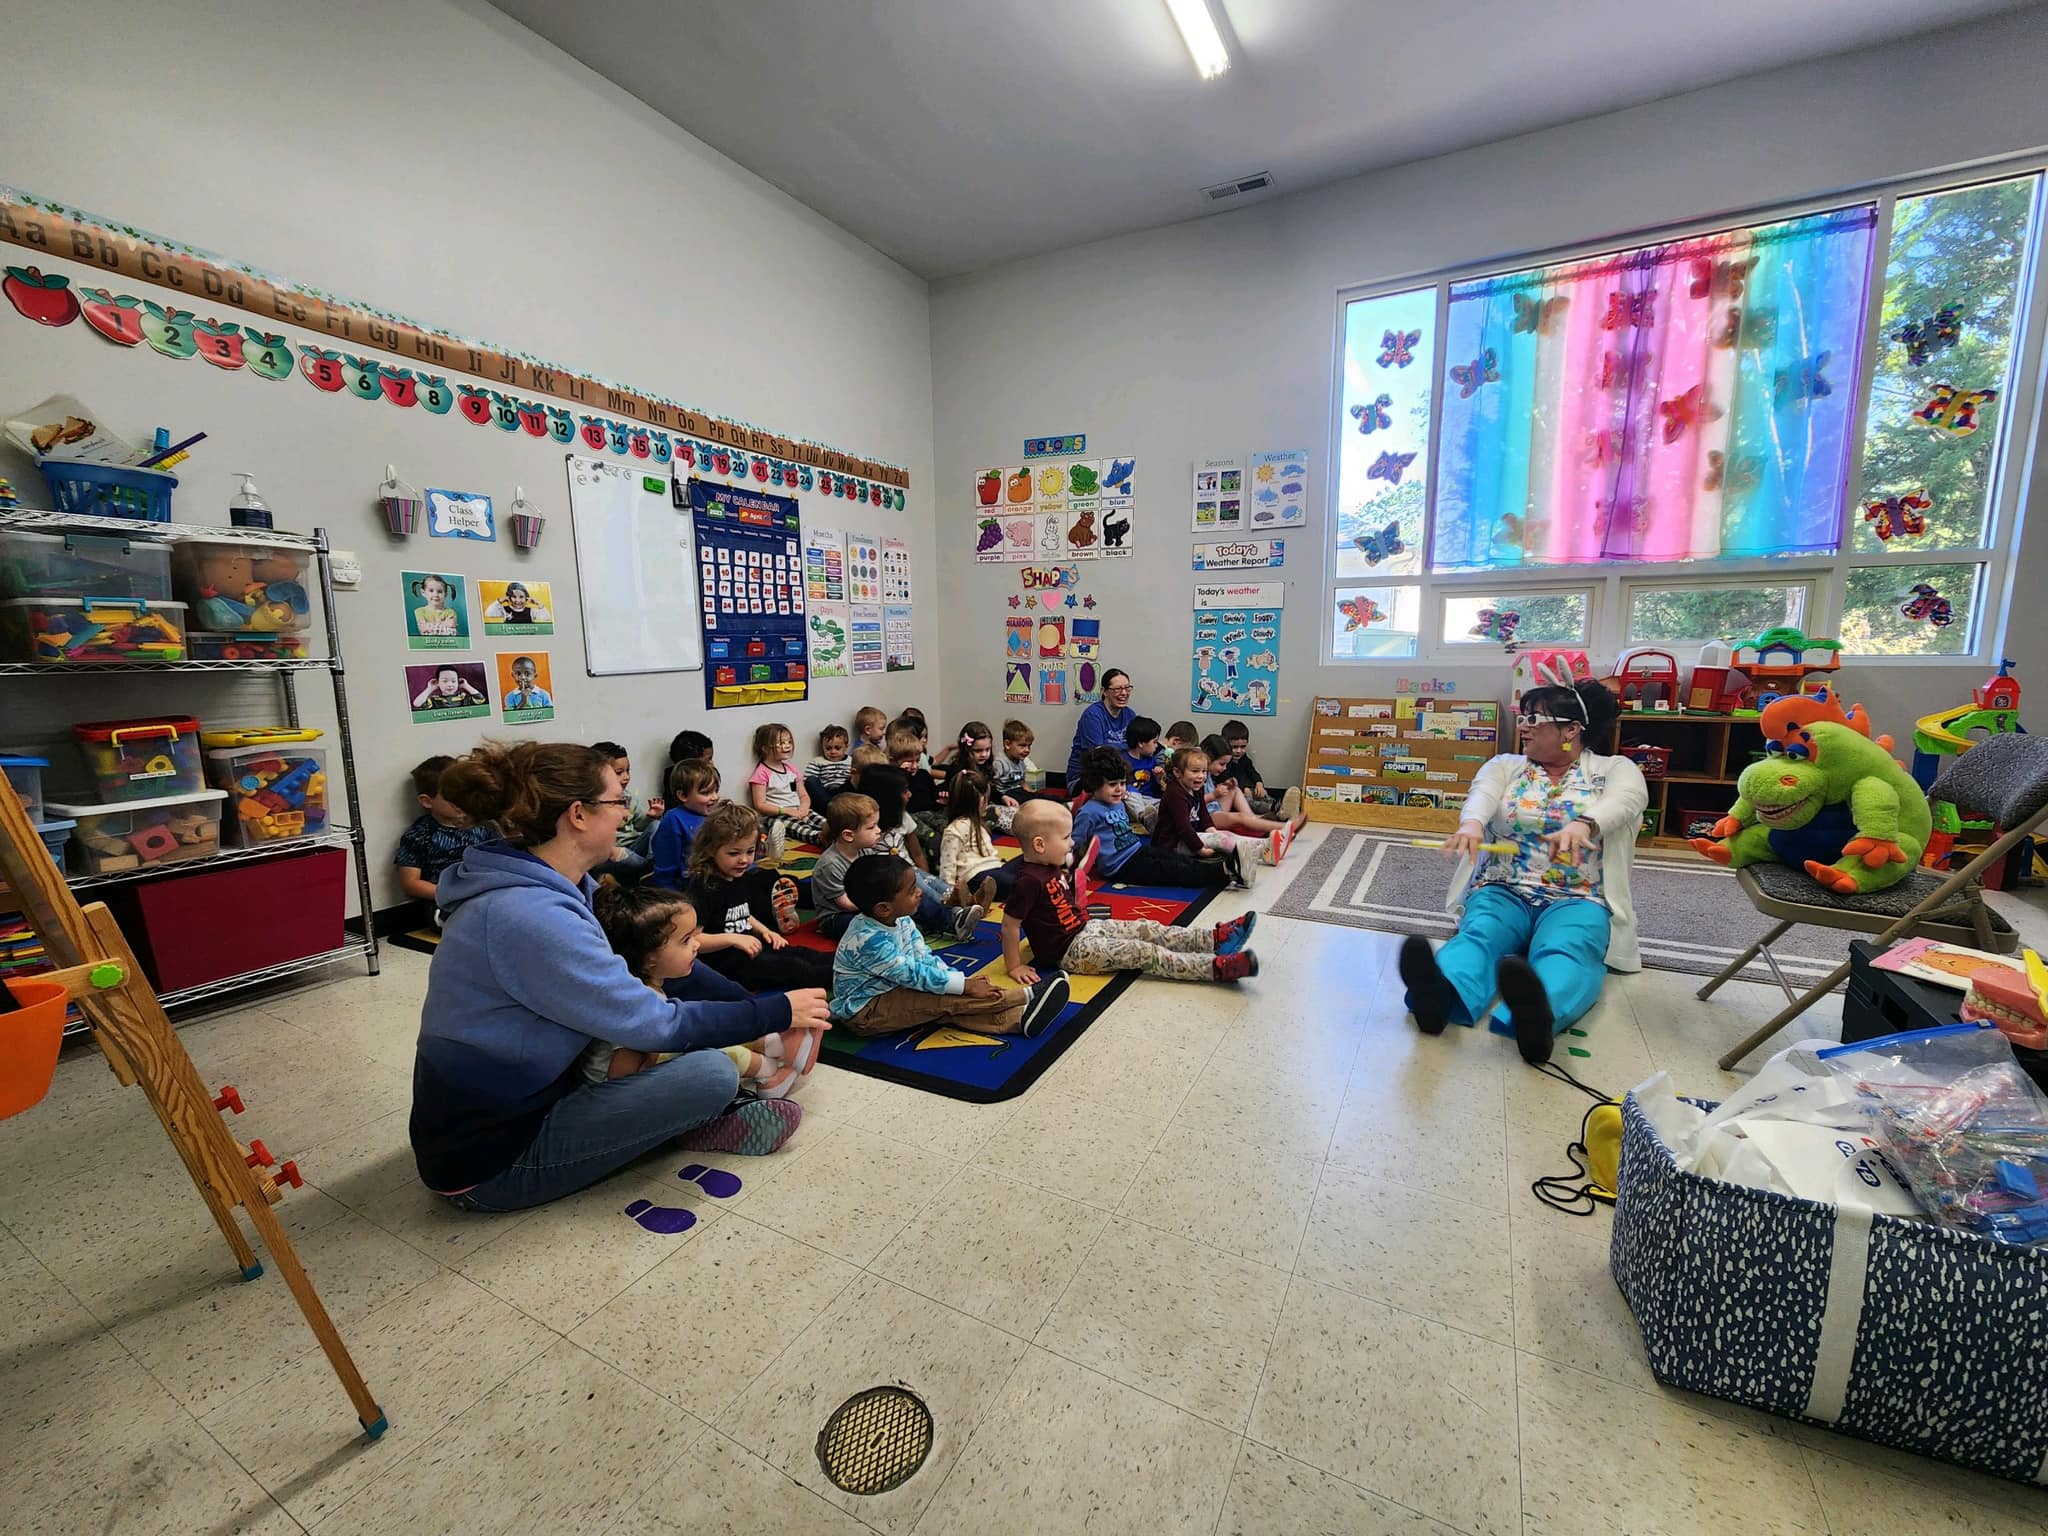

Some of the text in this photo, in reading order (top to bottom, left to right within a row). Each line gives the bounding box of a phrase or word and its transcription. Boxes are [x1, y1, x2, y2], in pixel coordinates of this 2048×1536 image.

[70, 229, 119, 268] Bb
[141, 250, 184, 287] Cc
[202, 269, 244, 304] Dd
[272, 288, 306, 321] Ee
[368, 320, 400, 350] Gg
[415, 336, 445, 362] Hh
[467, 349, 482, 373] Ii
[500, 360, 516, 384] Jj
[533, 368, 555, 393] Kk
[569, 379, 585, 401] Ll
[607, 391, 636, 415] Mm
[647, 403, 666, 423] Nn
[678, 412, 695, 431] Oo
[709, 421, 724, 440] Pp
[730, 428, 746, 446] Qq
[752, 434, 764, 449] Rr
[771, 439, 784, 456] Ss
[791, 444, 801, 460] Tt
[806, 447, 819, 463] Uu
[823, 449, 834, 467] Vv
[838, 455, 854, 473] Ww
[109, 311, 123, 332] 1
[164, 326, 182, 347] 2
[215, 338, 231, 358] 3
[260, 351, 278, 369] 4
[319, 365, 332, 382] 5
[358, 374, 371, 391] 6
[394, 382, 406, 398] 7
[428, 390, 441, 406] 8
[471, 401, 482, 415] 9
[497, 407, 515, 424] 10
[528, 415, 541, 430] 11
[553, 422, 569, 436] 12
[587, 428, 601, 443] 13
[611, 434, 625, 448] 14
[634, 438, 646, 452] 15
[654, 443, 667, 456] 16
[680, 448, 691, 461] 17
[699, 453, 710, 466] 18
[717, 456, 727, 469] 19
[732, 461, 745, 473] 20
[756, 465, 766, 477] 21
[771, 468, 781, 480] 22
[785, 473, 796, 482] 23
[800, 475, 810, 485] 24
[1028, 437, 1083, 453] COLORS
[1264, 452, 1296, 462] Weather
[1205, 459, 1234, 467] Seasons
[715, 492, 780, 512] MY CALENDAR
[1073, 501, 1094, 509] green
[449, 504, 473, 515] Class
[1007, 505, 1032, 514] orange
[1039, 503, 1063, 512] yellow
[449, 516, 480, 528] Helper
[1216, 543, 1258, 557] Today's
[979, 554, 1001, 562] purple
[1205, 557, 1269, 567] Weather Report
[1022, 567, 1078, 588] SHAPES
[1197, 586, 1260, 597] Today's weather
[1254, 613, 1274, 622] Foggy
[1253, 629, 1274, 638] Cloudy
[1039, 663, 1067, 671] SQUARE
[1396, 677, 1456, 693] Books
